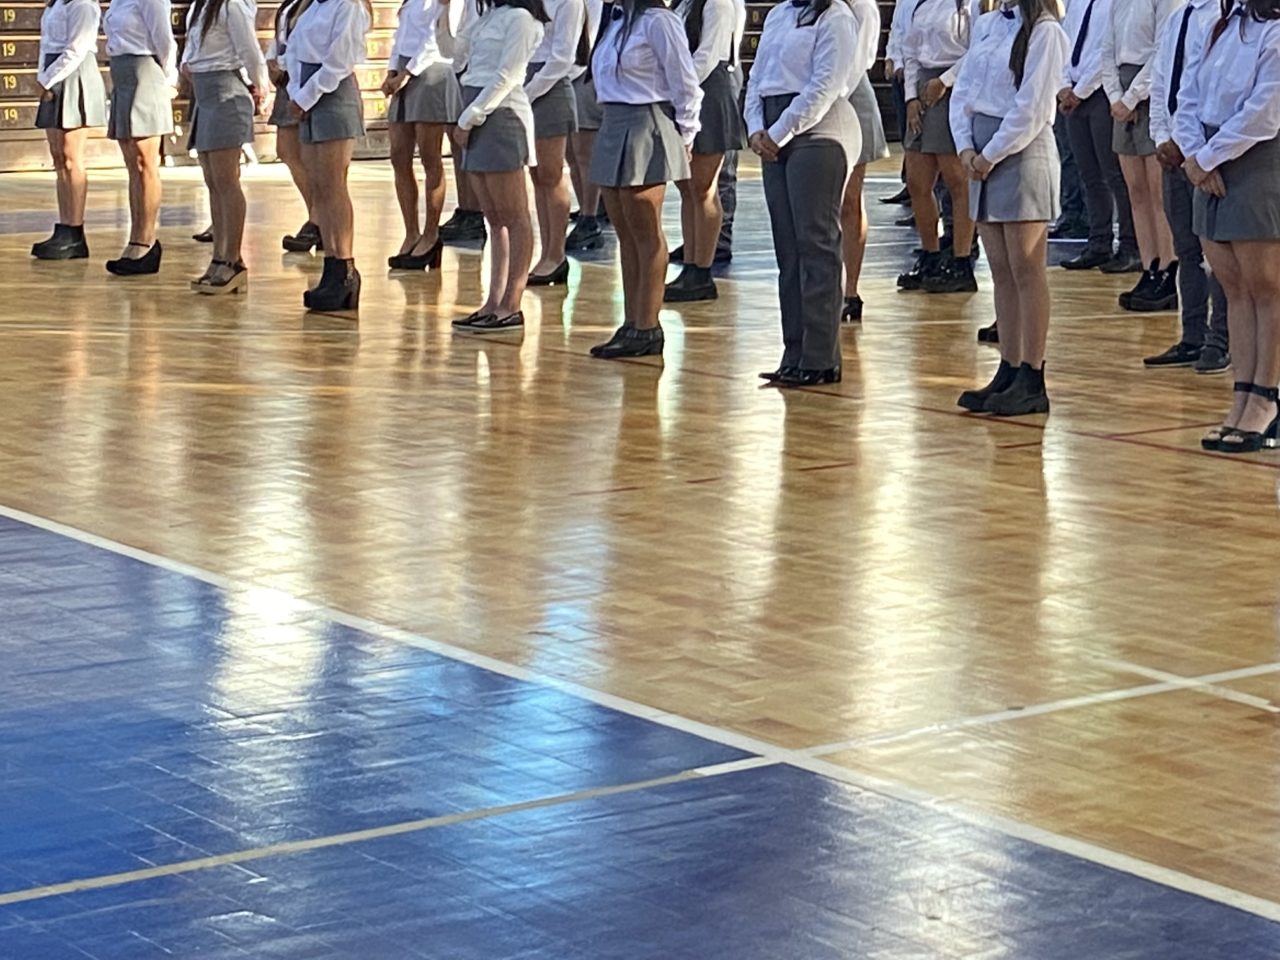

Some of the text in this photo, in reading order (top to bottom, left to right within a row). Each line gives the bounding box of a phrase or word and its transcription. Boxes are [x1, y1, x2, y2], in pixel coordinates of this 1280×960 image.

[3, 9, 16, 23] 19
[2, 42, 16, 57] 19
[3, 75, 17, 90] 19
